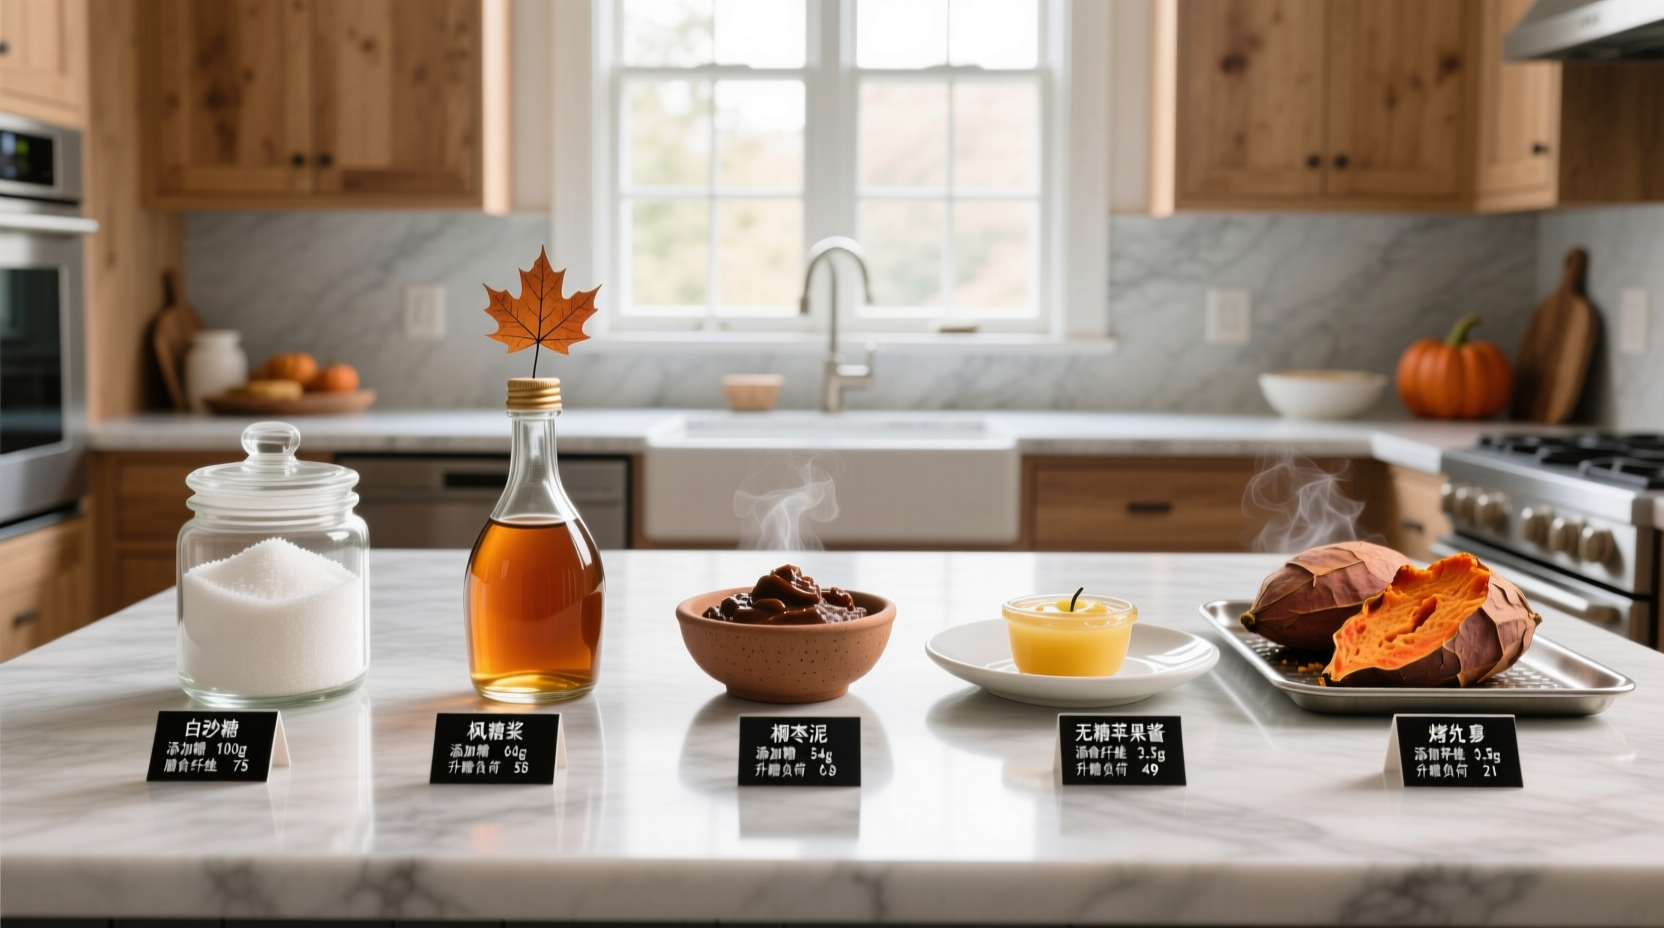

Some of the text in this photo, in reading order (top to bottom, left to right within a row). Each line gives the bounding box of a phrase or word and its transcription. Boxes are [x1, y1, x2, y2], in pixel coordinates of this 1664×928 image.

[217, 742, 247, 758] 100g
[233, 759, 249, 772] 75
[1141, 764, 1159, 776] 49
[1483, 765, 1497, 777] 21
